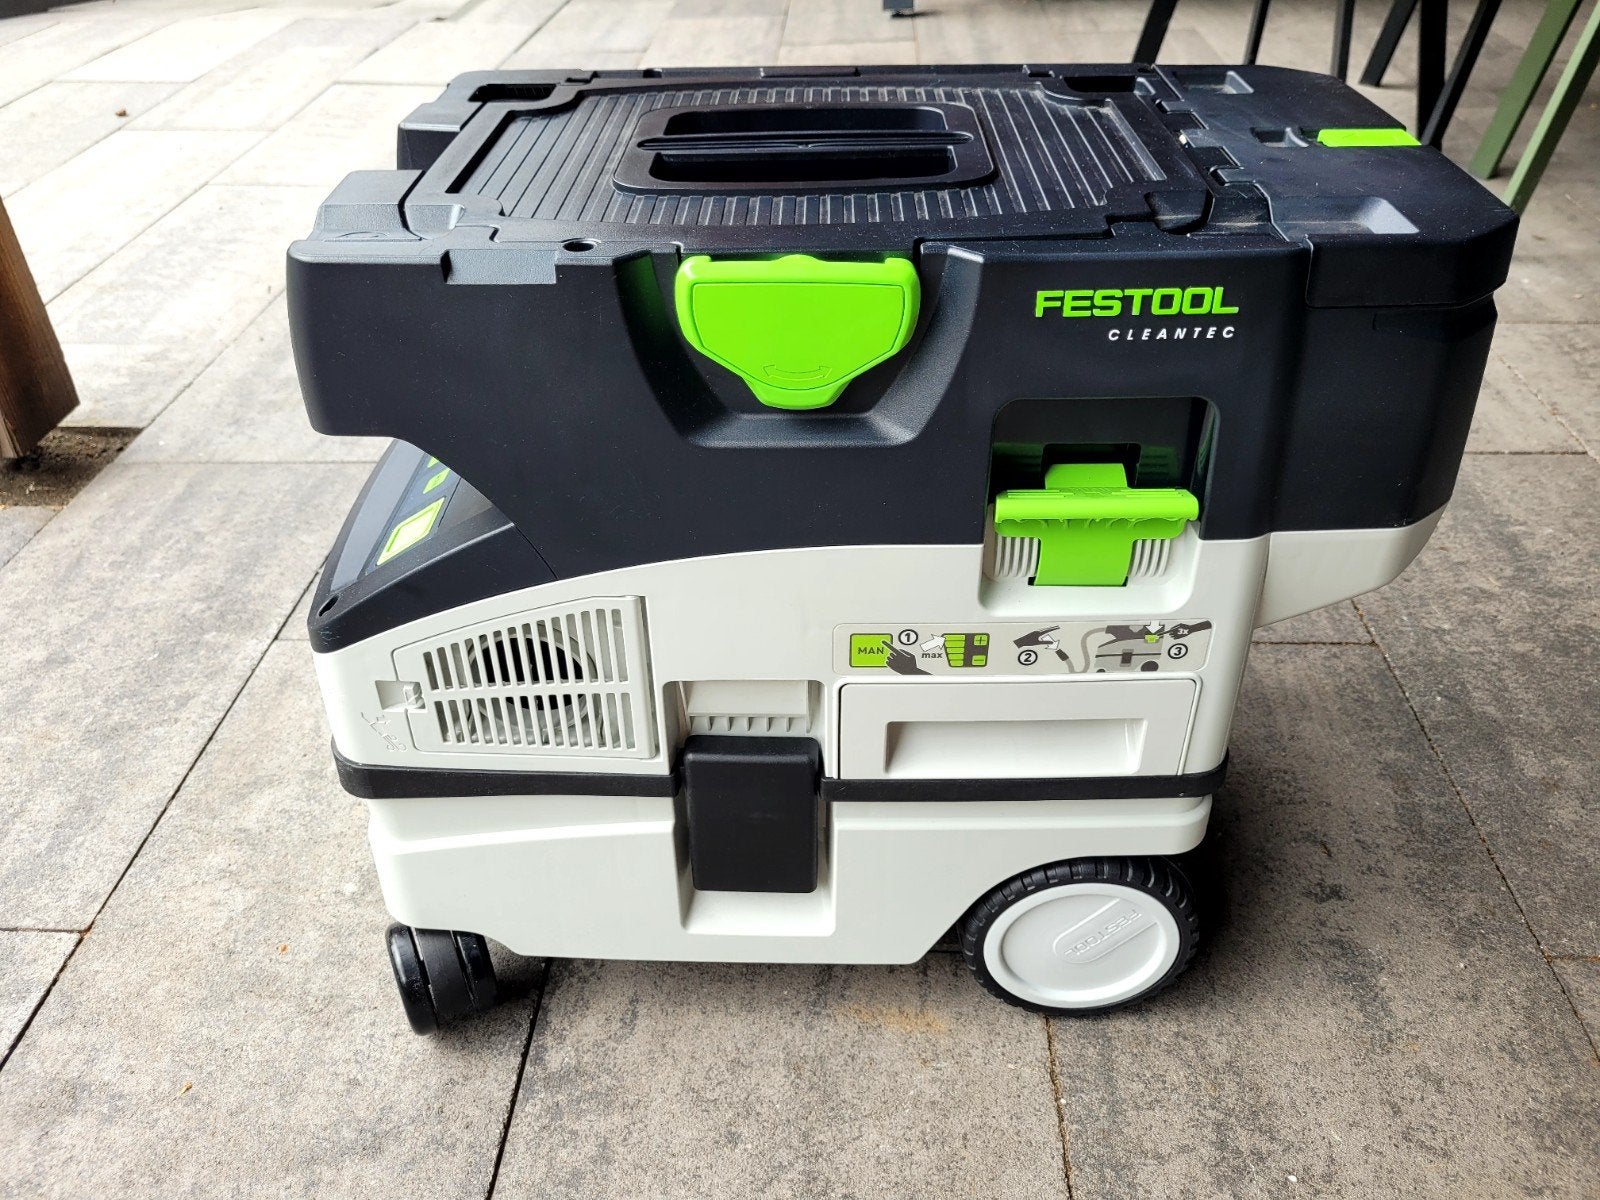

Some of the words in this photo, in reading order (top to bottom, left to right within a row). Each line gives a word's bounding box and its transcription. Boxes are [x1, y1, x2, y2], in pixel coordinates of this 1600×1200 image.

[1035, 286, 1239, 318] FESTOOL
[1107, 326, 1236, 341] CLEANTEC
[1177, 627, 1189, 635] 3x
[857, 646, 884, 655] MAN
[921, 651, 943, 659] max
[1063, 909, 1142, 958] FESTOOL
